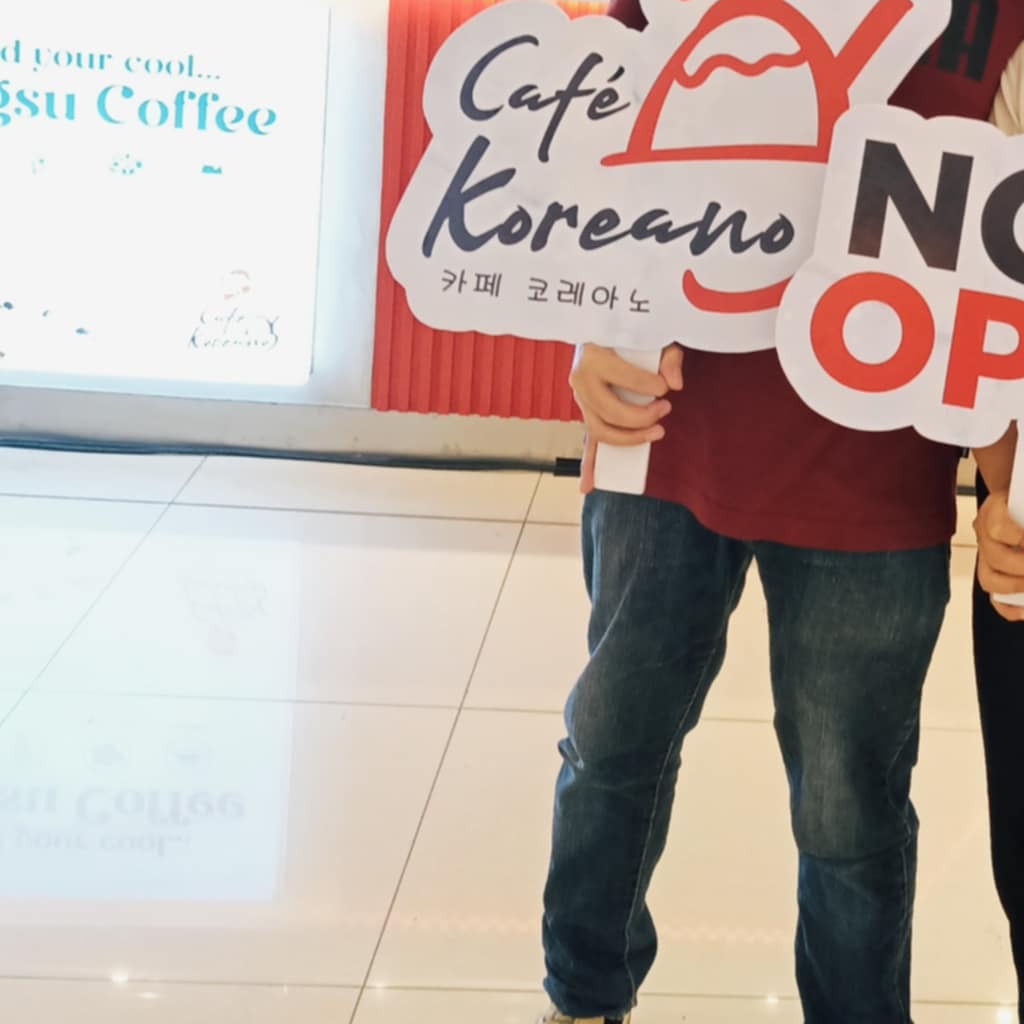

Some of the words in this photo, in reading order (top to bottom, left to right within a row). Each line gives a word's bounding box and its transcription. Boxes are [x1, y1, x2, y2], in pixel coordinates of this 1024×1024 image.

[32, 48, 113, 73] your
[124, 54, 221, 80] cool...
[96, 83, 278, 137] Coffee
[459, 34, 631, 164] Café
[421, 134, 796, 259] Koreano
[441, 268, 503, 299] 카페
[527, 276, 652, 315] 코레아노
